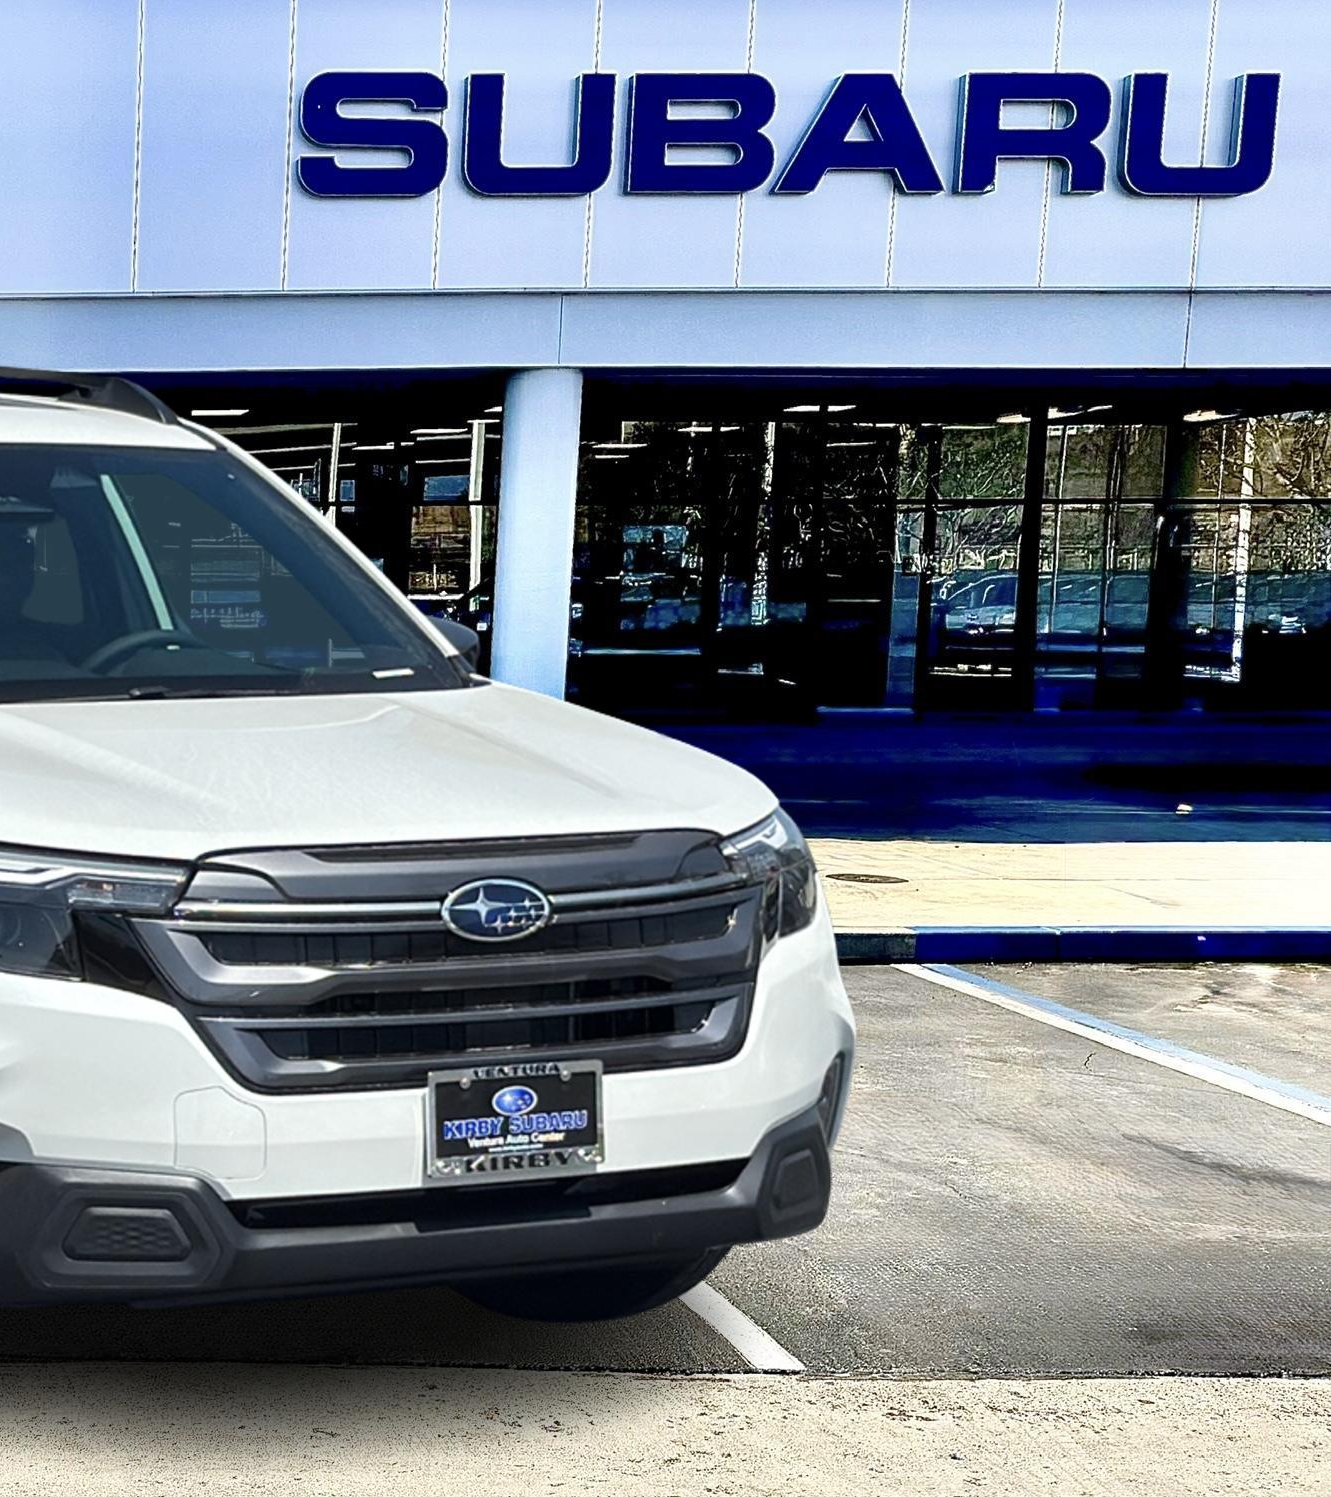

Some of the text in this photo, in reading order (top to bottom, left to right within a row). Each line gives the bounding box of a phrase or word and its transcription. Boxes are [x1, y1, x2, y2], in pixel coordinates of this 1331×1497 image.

[298, 72, 1281, 197] SUBARU
[474, 1063, 560, 1079] VENTURA
[444, 1111, 587, 1139] KIRBY SUBARU
[467, 1135, 504, 1148] Ventura
[505, 1134, 529, 1145] Auto
[531, 1132, 565, 1143] Center
[467, 1152, 573, 1172] KIRBY
